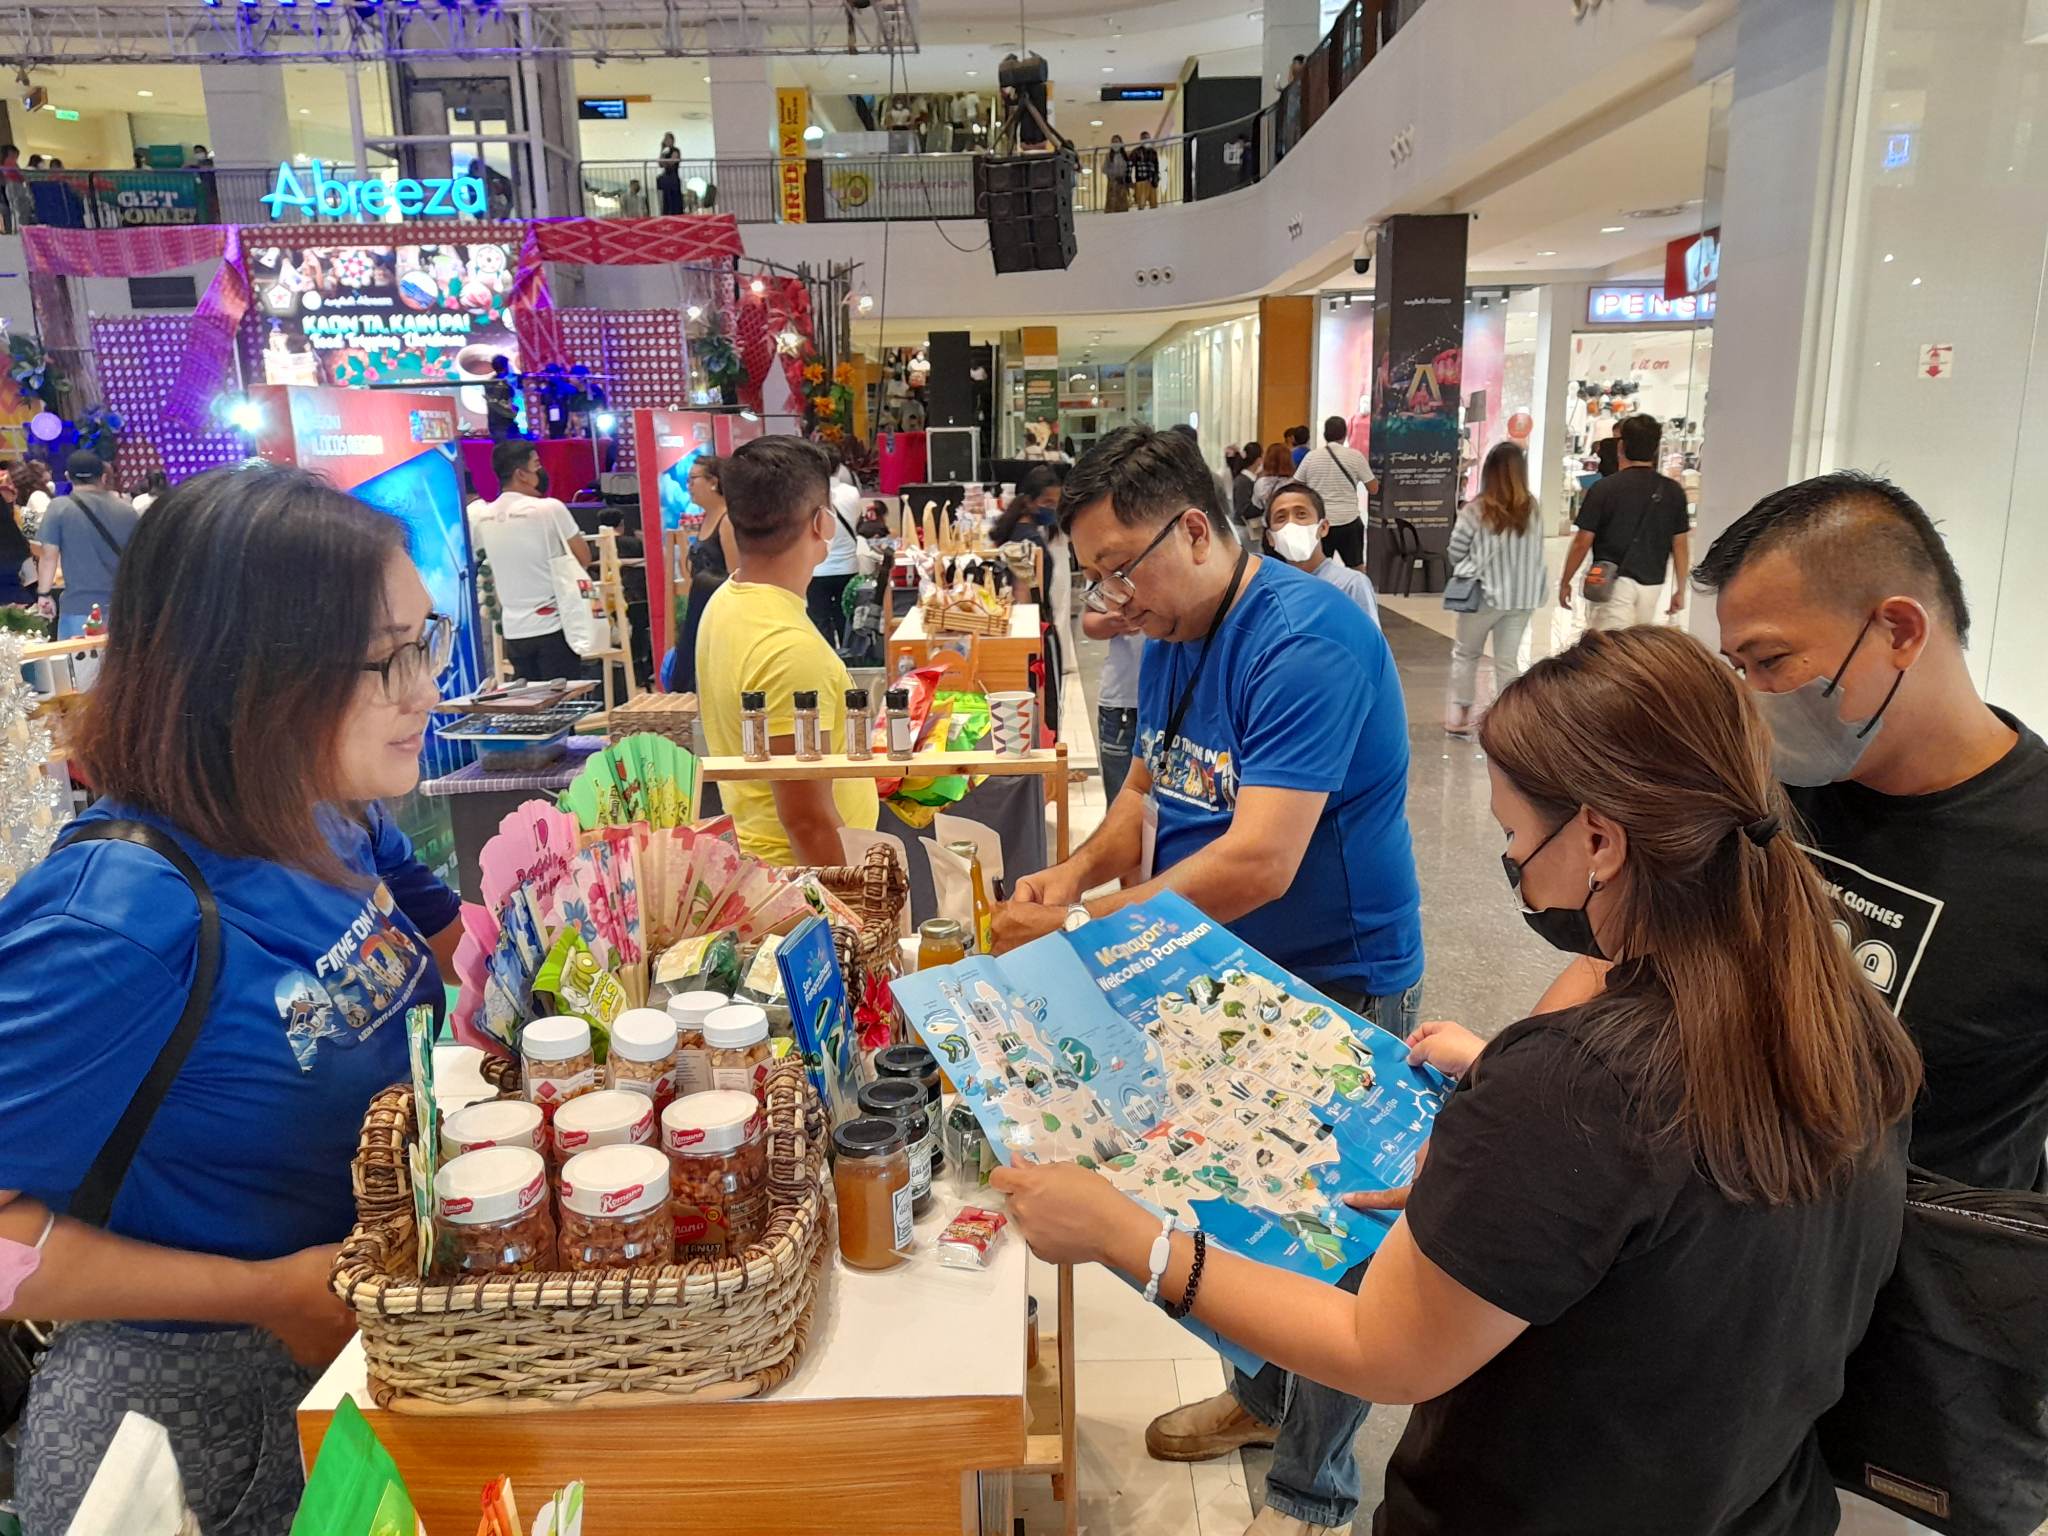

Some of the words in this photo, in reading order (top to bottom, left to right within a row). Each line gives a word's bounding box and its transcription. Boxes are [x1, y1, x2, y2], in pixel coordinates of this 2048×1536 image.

[117, 190, 179, 208] GET
[260, 159, 487, 218] Abreeza
[1652, 359, 1670, 370] on
[1844, 890, 1905, 929] CLOTHES
[671, 1130, 705, 1147] Romana
[601, 1186, 643, 1213] Romana
